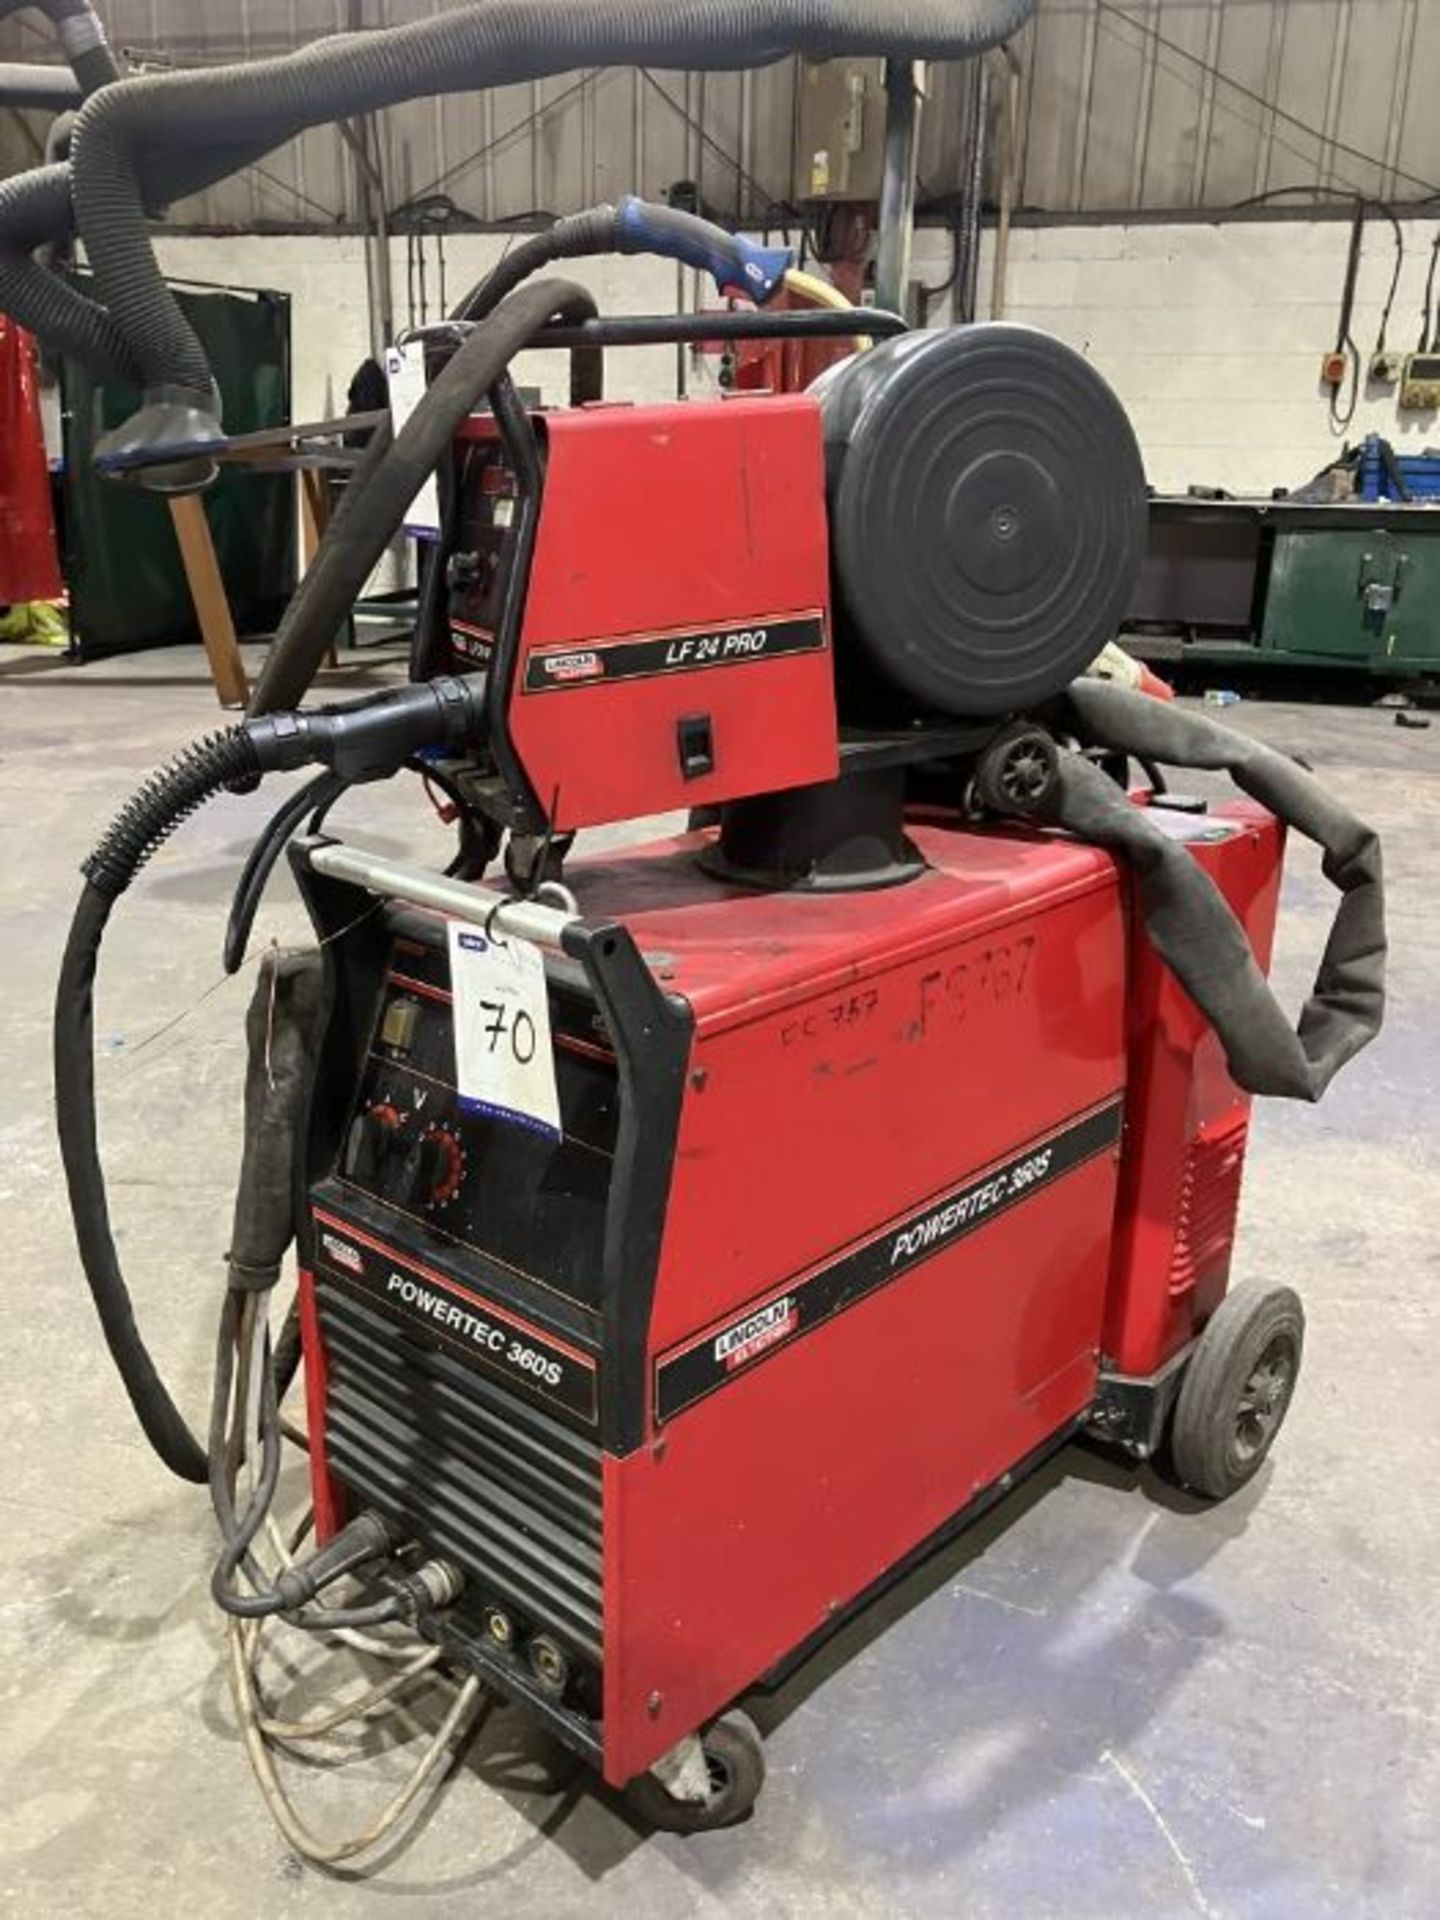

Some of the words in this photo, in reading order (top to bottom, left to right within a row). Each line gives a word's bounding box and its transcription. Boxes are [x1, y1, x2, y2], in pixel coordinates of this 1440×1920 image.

[665, 640, 693, 665] LF
[698, 636, 721, 660] 24
[722, 629, 768, 657] PRO
[479, 1000, 536, 1065] 70
[889, 1175, 1008, 1265] POWERTEC
[1007, 1147, 1055, 1195] 360S
[386, 1272, 506, 1352] POWERTEC
[506, 1341, 563, 1386] 360S
[717, 1299, 788, 1358] LINCOLN
